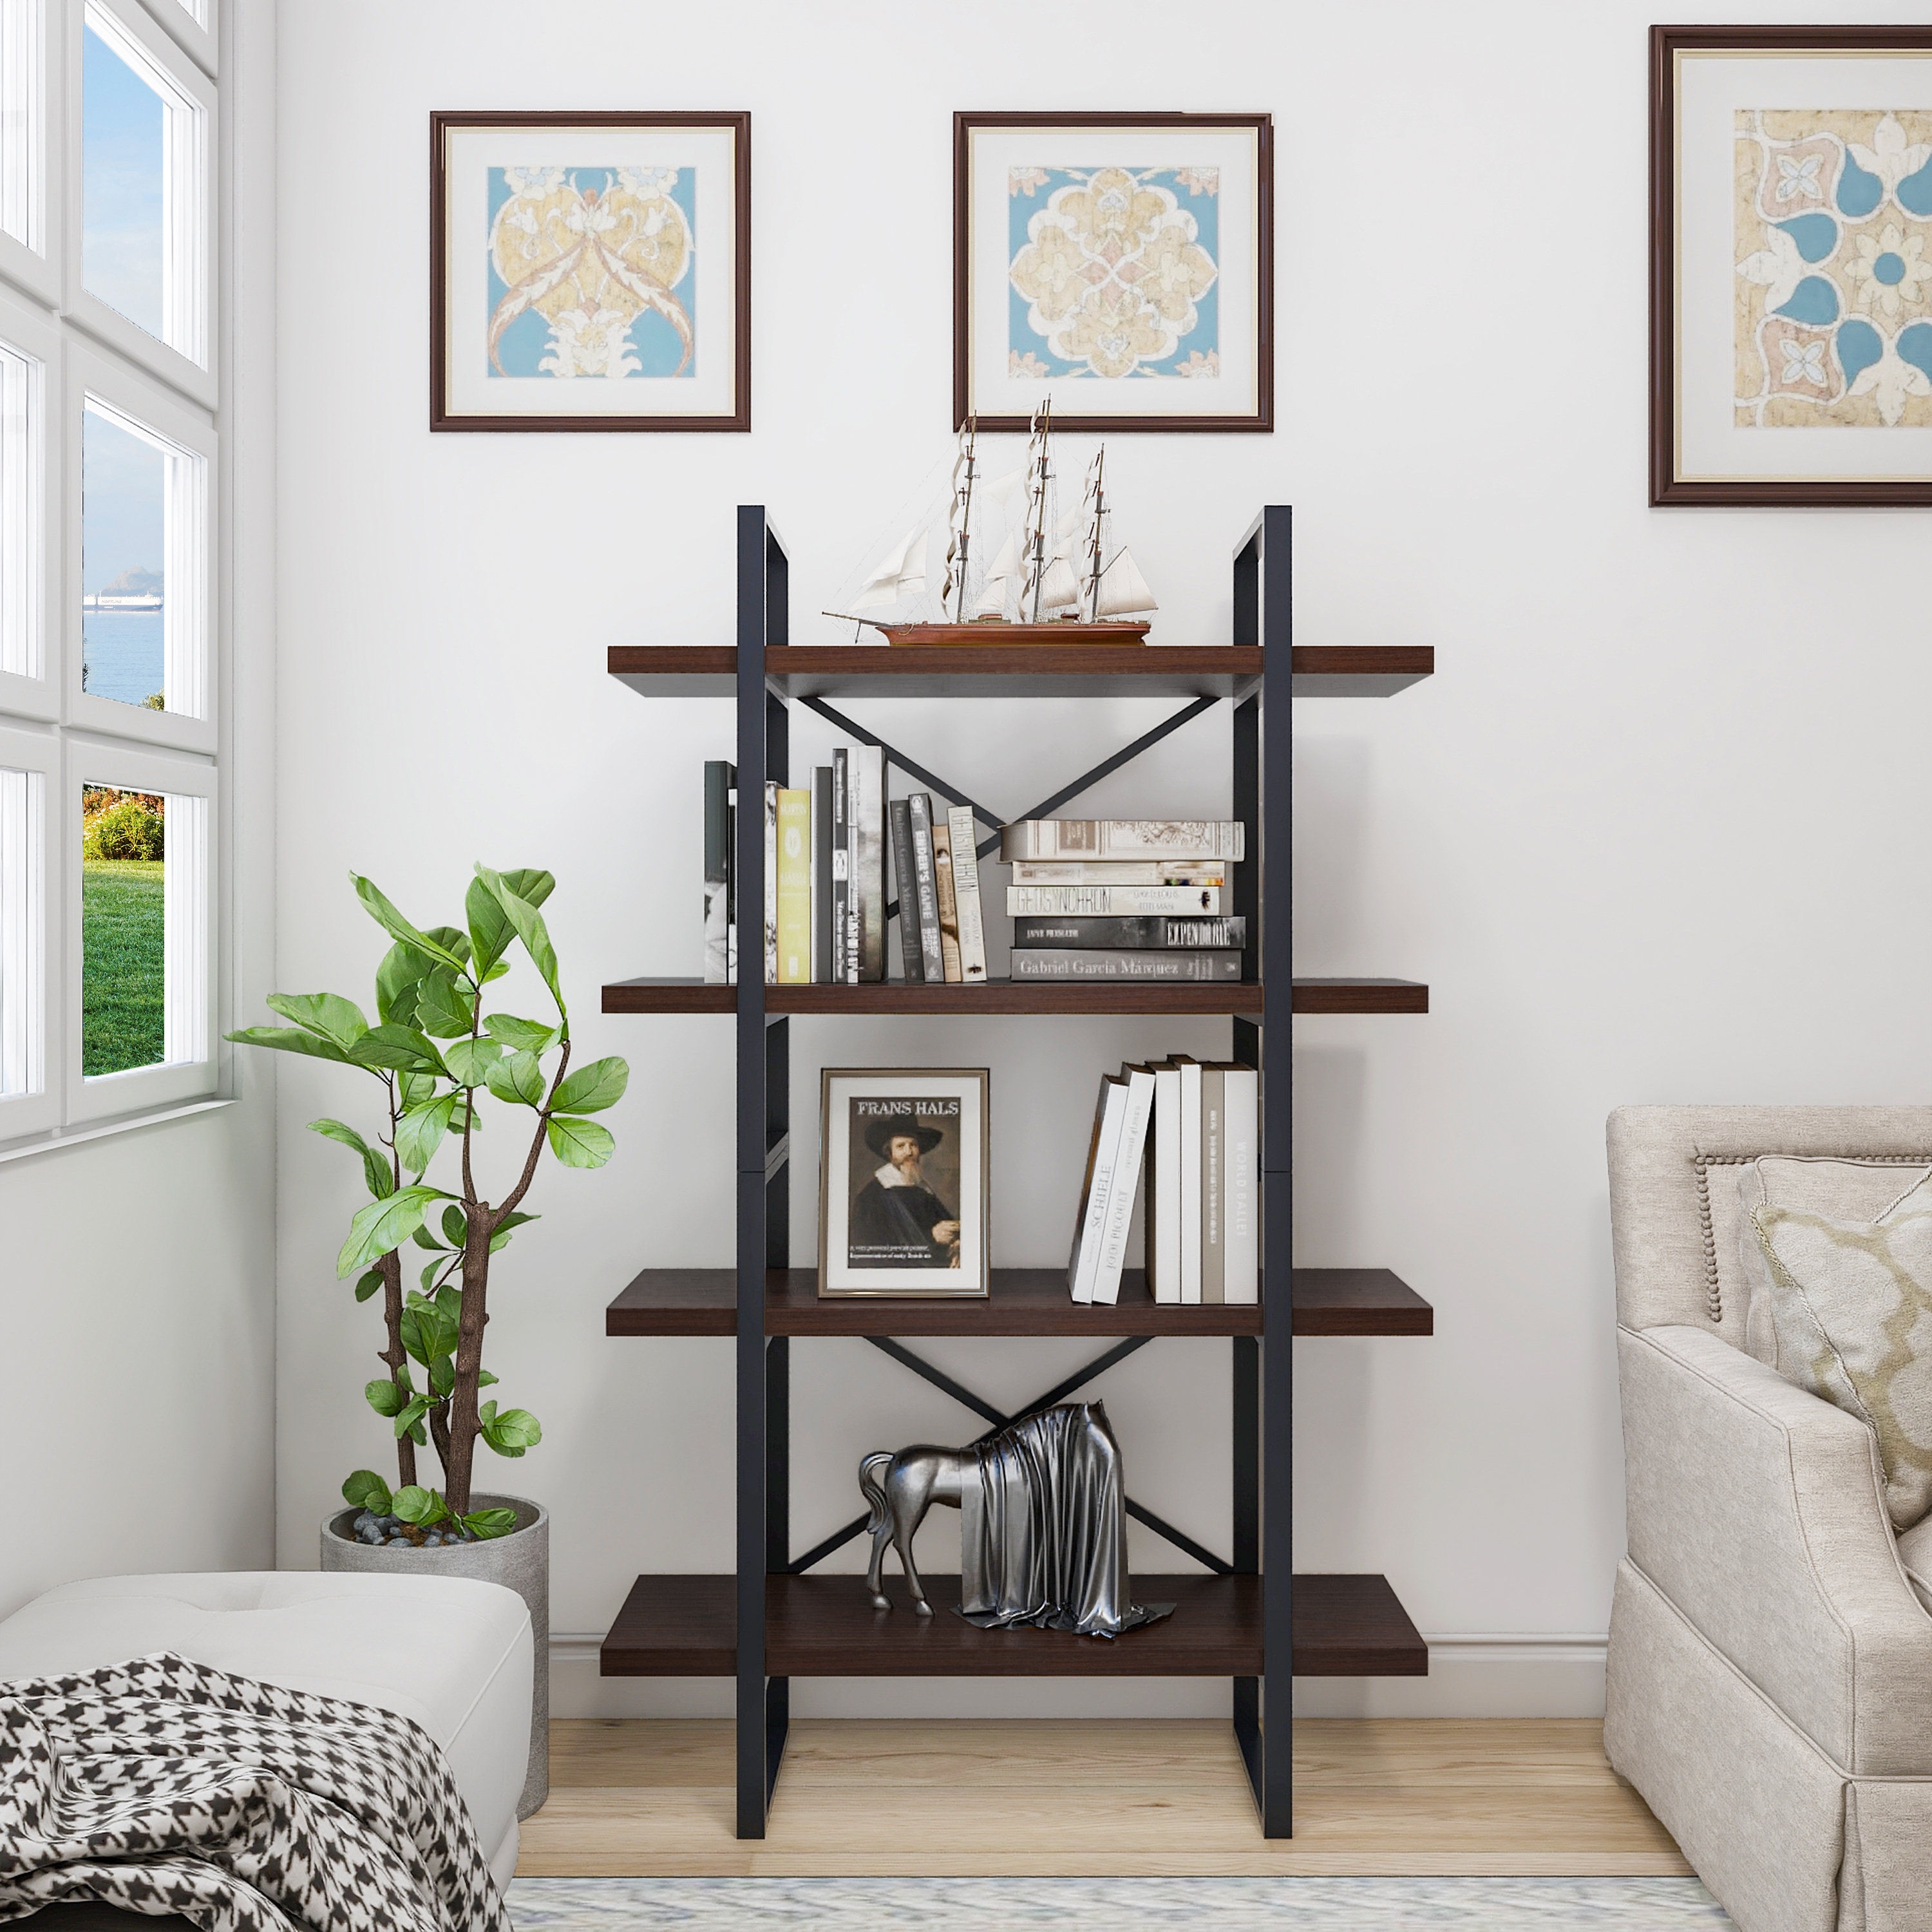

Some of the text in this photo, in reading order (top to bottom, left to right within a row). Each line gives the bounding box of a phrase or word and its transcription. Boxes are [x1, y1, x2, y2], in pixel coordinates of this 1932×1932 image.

[914, 829, 933, 920] ENDER'S GAME
[1020, 958, 1069, 974] Gabriel
[857, 1101, 959, 1115] FRANS HALS
[1092, 1164, 1111, 1229] SCHIELE
[1236, 1141, 1247, 1236] WORLD BALLET
